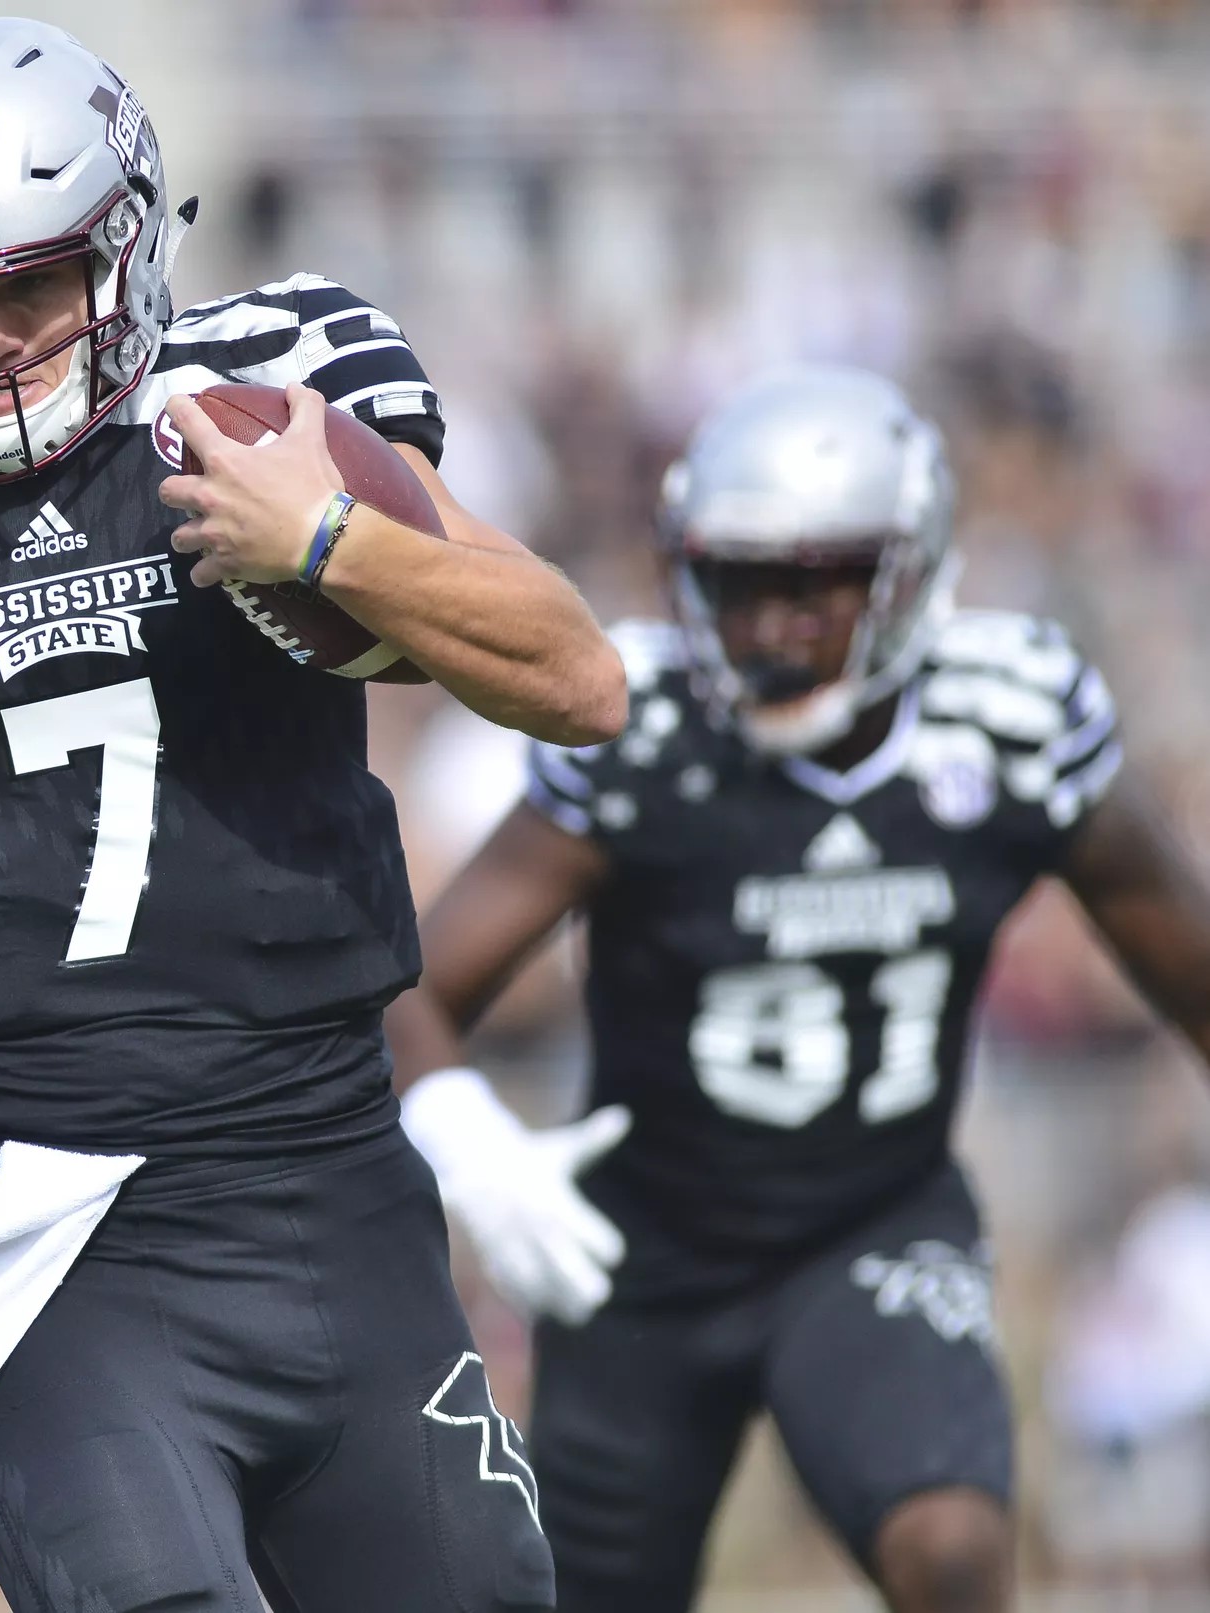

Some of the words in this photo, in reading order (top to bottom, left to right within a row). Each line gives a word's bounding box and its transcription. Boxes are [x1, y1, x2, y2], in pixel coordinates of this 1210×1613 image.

[11, 532, 88, 563] adidas
[8, 622, 115, 667] STATE
[0, 677, 161, 964] 7
